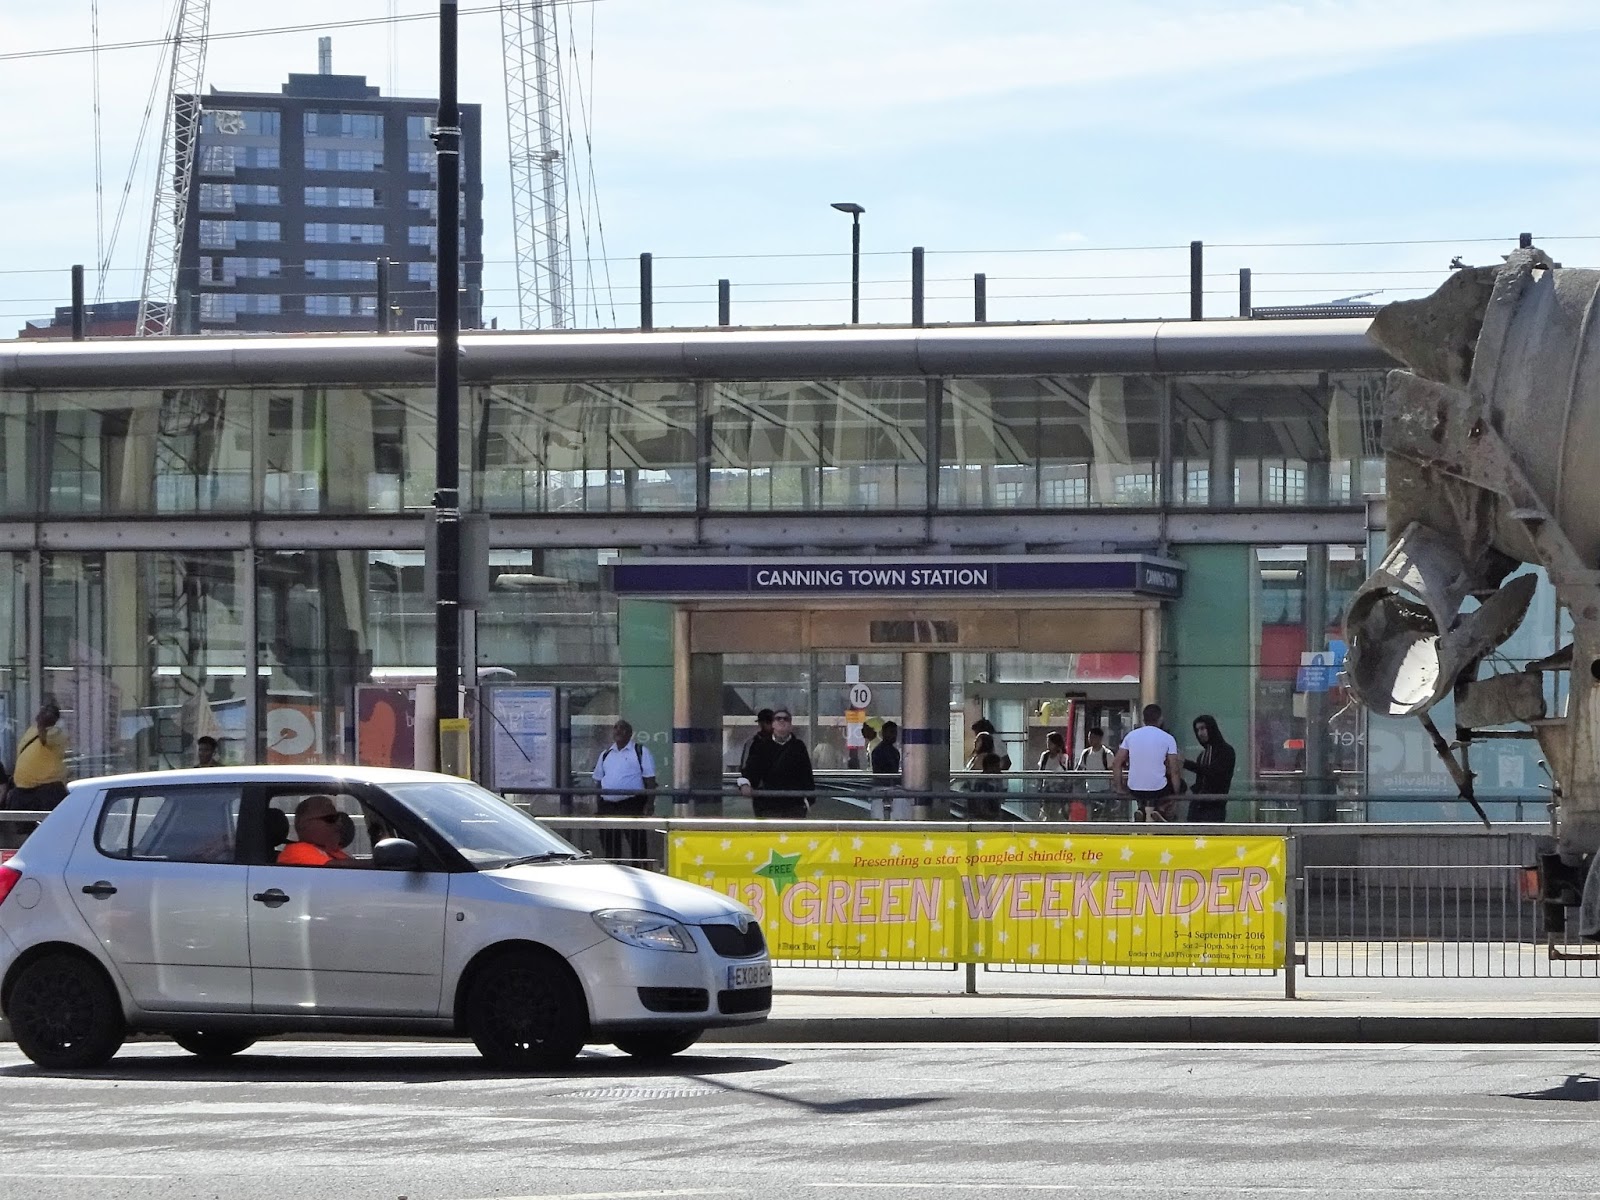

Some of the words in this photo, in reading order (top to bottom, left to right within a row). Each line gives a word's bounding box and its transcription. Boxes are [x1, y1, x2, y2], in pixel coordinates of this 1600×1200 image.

[756, 570, 843, 586] CANNING
[848, 570, 905, 586] TOWN
[911, 569, 988, 586] STATION
[854, 689, 868, 703] 10
[854, 854, 919, 868] Presenting
[923, 856, 932, 865] a
[936, 853, 961, 864] star
[965, 850, 1024, 866] spangled
[1028, 849, 1076, 864] shindig,
[1082, 849, 1103, 861] the
[769, 865, 792, 875] FREE
[782, 876, 941, 924] GREEN
[960, 867, 1269, 919] WEEKENDER
[1195, 931, 1242, 941] September
[1246, 931, 1265, 940] 2016
